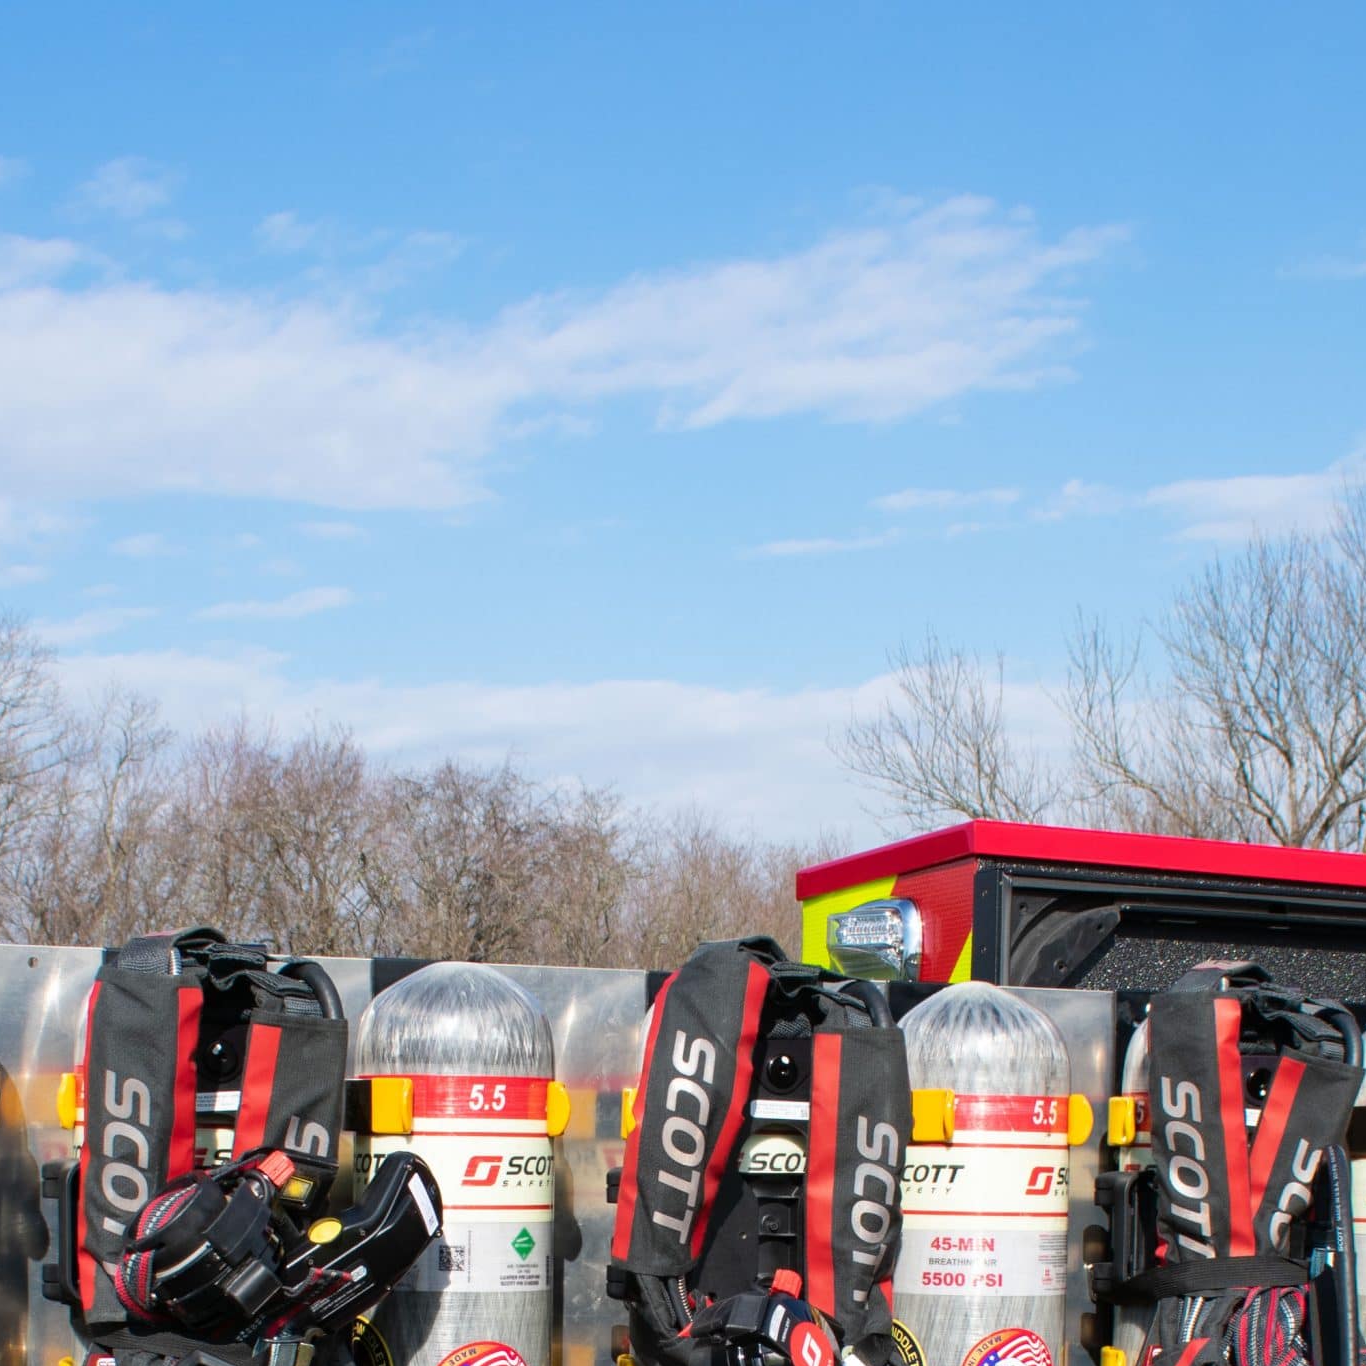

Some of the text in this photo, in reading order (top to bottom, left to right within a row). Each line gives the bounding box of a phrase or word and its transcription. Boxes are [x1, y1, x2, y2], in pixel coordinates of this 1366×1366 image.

[468, 1084, 506, 1111] 5.5
[1032, 1100, 1059, 1126] 5.5
[653, 1030, 716, 1245] SCOTT
[747, 1152, 806, 1173] SCO
[930, 1236, 996, 1252] 45-MN
[928, 1257, 972, 1267] BREATHIN
[921, 1271, 966, 1287] 5500
